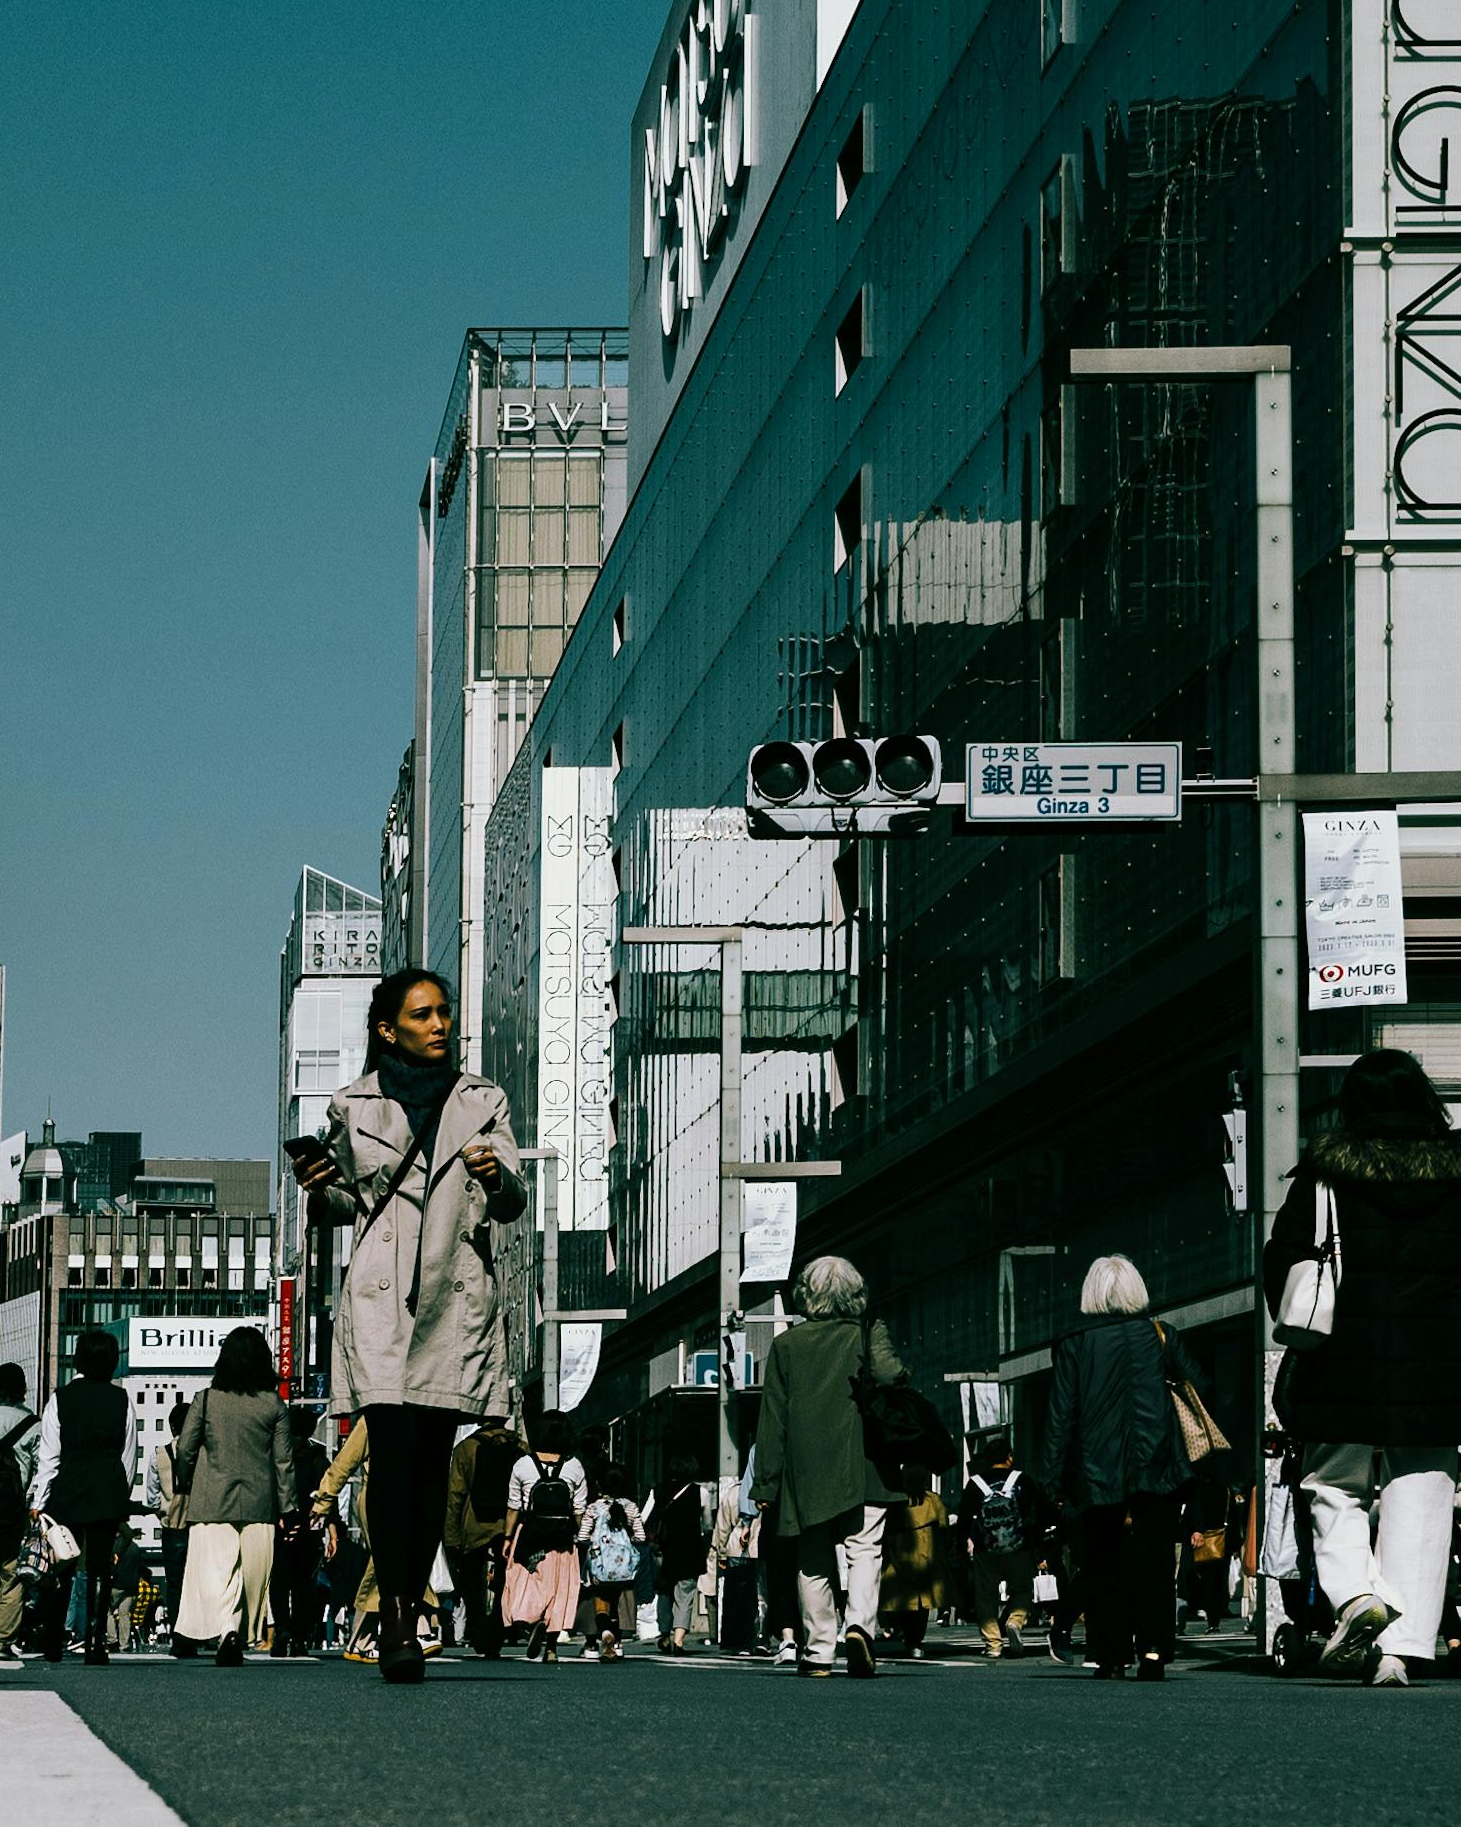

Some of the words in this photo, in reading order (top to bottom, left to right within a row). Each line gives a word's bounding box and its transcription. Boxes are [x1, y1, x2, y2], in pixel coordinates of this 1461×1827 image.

[982, 746, 1039, 762] 中央区
[981, 763, 1165, 795] 銀座三丁目
[1037, 797, 1089, 814] Ginza
[1098, 797, 1110, 813] 3
[1324, 820, 1380, 831] GINZA
[314, 930, 378, 941] KIRA
[314, 943, 378, 955] RITO
[314, 957, 378, 967] GINZA
[1348, 964, 1396, 978] MUFG
[1321, 984, 1396, 1000] 三菱UFJ銀行
